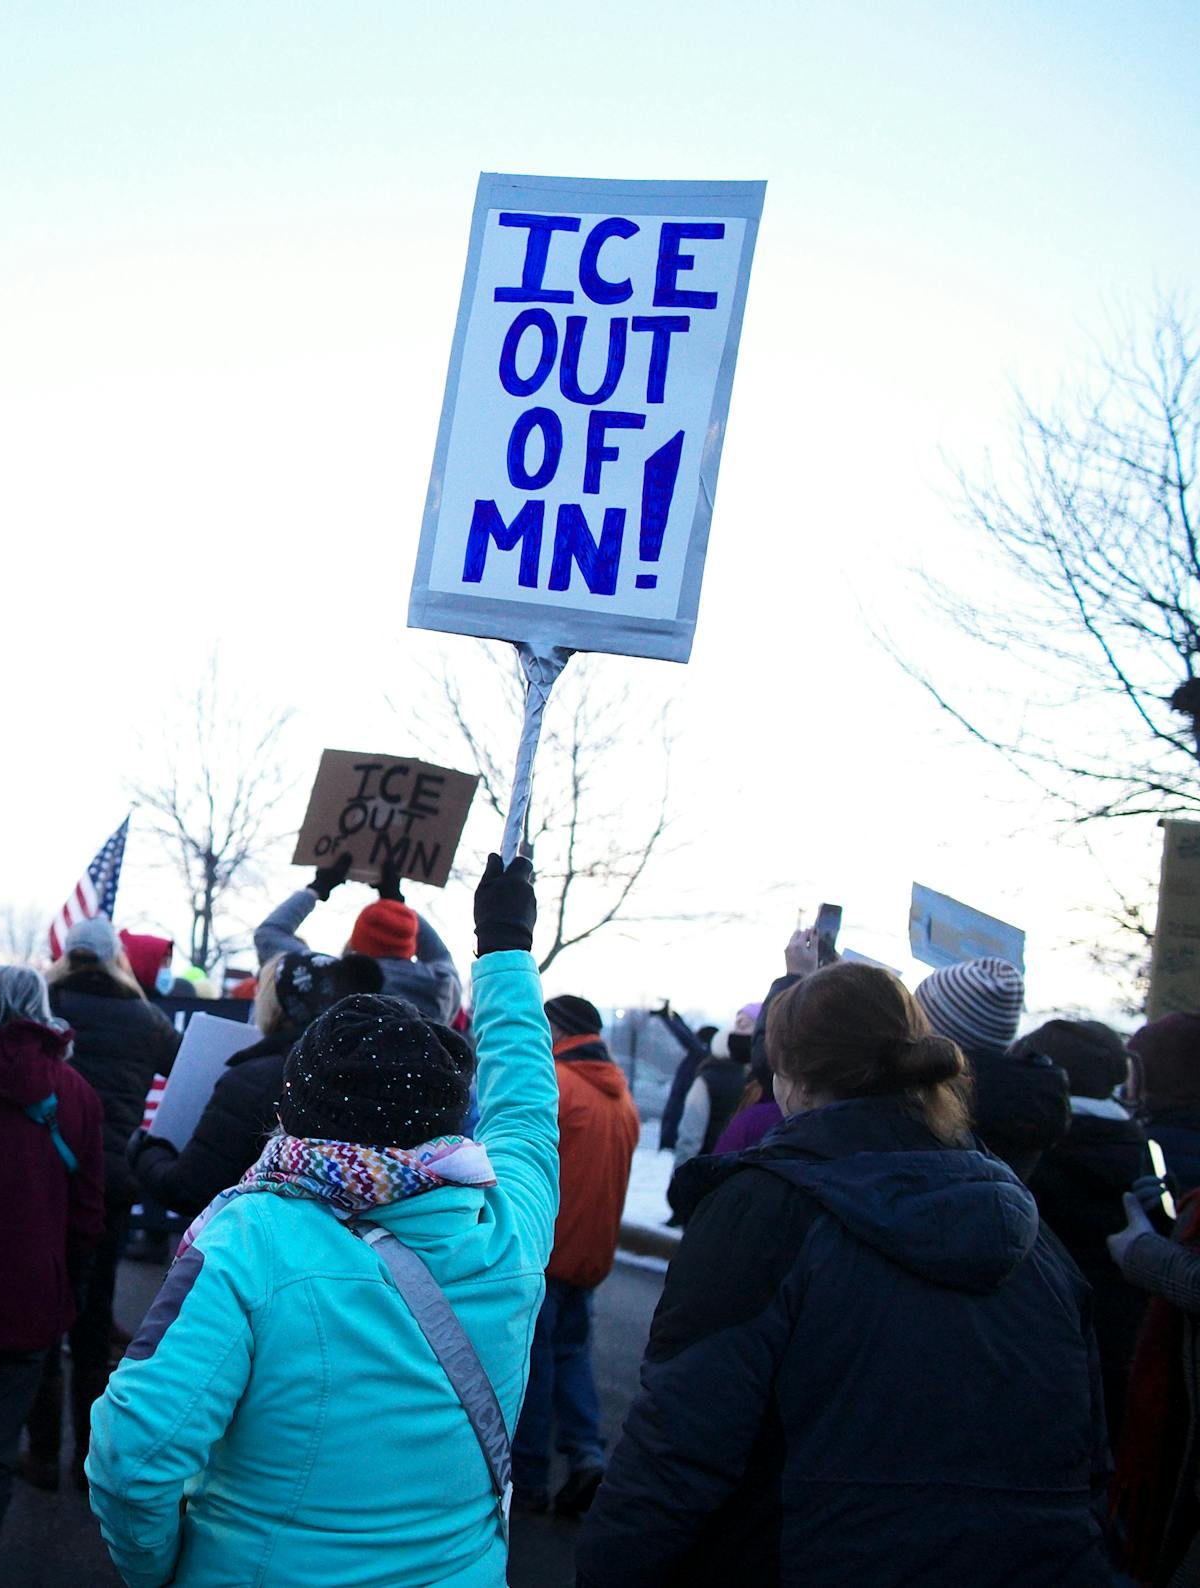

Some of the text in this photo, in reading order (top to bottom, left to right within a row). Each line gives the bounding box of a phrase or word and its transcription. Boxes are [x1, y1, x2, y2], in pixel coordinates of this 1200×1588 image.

[494, 212, 725, 309] ICE
[499, 308, 690, 405] OUT
[507, 406, 647, 494] OF
[462, 430, 685, 595] MN!
[339, 802, 426, 836] OUT
[347, 763, 445, 815] ICE
[314, 831, 440, 878] OF MN
